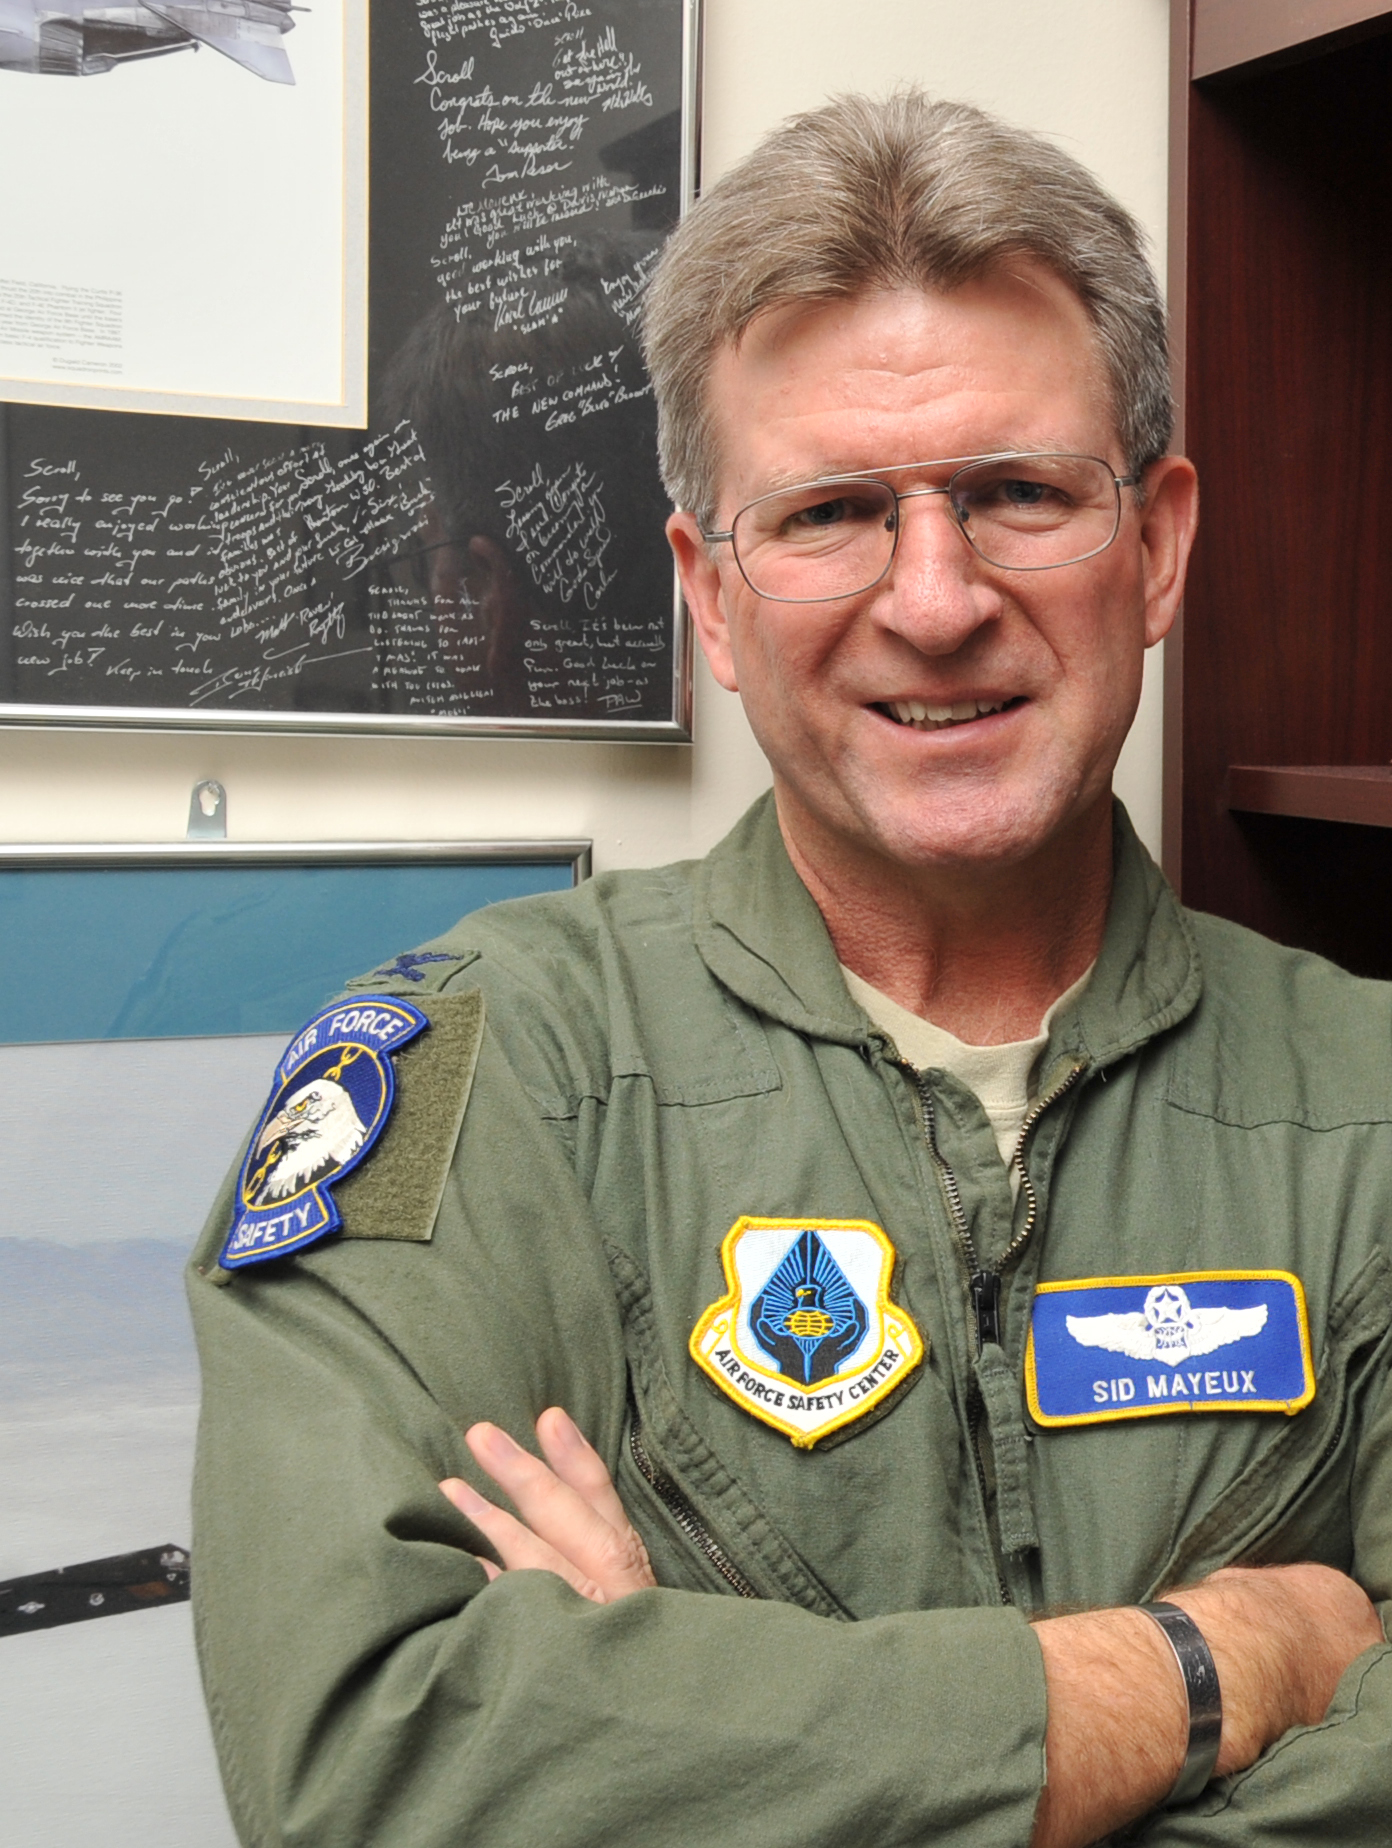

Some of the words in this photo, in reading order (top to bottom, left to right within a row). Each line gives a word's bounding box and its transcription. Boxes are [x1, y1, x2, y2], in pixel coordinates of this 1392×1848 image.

[414, 50, 475, 85] Scroll
[430, 86, 500, 117] Congrats
[502, 94, 523, 107] on
[523, 82, 557, 108] the
[557, 93, 602, 108] new
[509, 116, 543, 137] you
[546, 115, 589, 140] enjoy
[484, 145, 497, 155] a
[445, 287, 463, 304] the
[467, 275, 491, 295] best
[492, 406, 520, 423] THE
[532, 393, 558, 414] NEW
[75, 488, 92, 502] to
[101, 493, 123, 502] see
[111, 494, 157, 516] you
[36, 516, 81, 543] really
[95, 517, 160, 542] enjoyed
[14, 538, 75, 568] together
[84, 542, 122, 557] with
[116, 548, 156, 571] you
[167, 543, 201, 556] and
[16, 573, 43, 584] was
[52, 572, 85, 585] nice
[90, 571, 134, 585] that
[141, 577, 165, 585] our
[167, 571, 216, 594] paths
[15, 592, 76, 608] crossed
[84, 599, 112, 609] one
[123, 599, 158, 610] more
[52, 628, 86, 649] you
[90, 623, 120, 638] the
[130, 619, 165, 638] best
[171, 625, 185, 638] in
[17, 655, 51, 666] new
[147, 663, 164, 675] in
[171, 658, 213, 674] touch
[527, 679, 560, 692] your
[286, 1028, 318, 1070] AIR
[328, 1009, 404, 1041] FORCE
[232, 1201, 312, 1249] SAFETY
[715, 1348, 741, 1378] AIR
[736, 1371, 784, 1408] FORCE
[786, 1389, 845, 1412] SAFETY
[848, 1348, 900, 1400] CENTER
[1092, 1377, 1136, 1403] SID
[1147, 1370, 1258, 1399] MAYEUX
